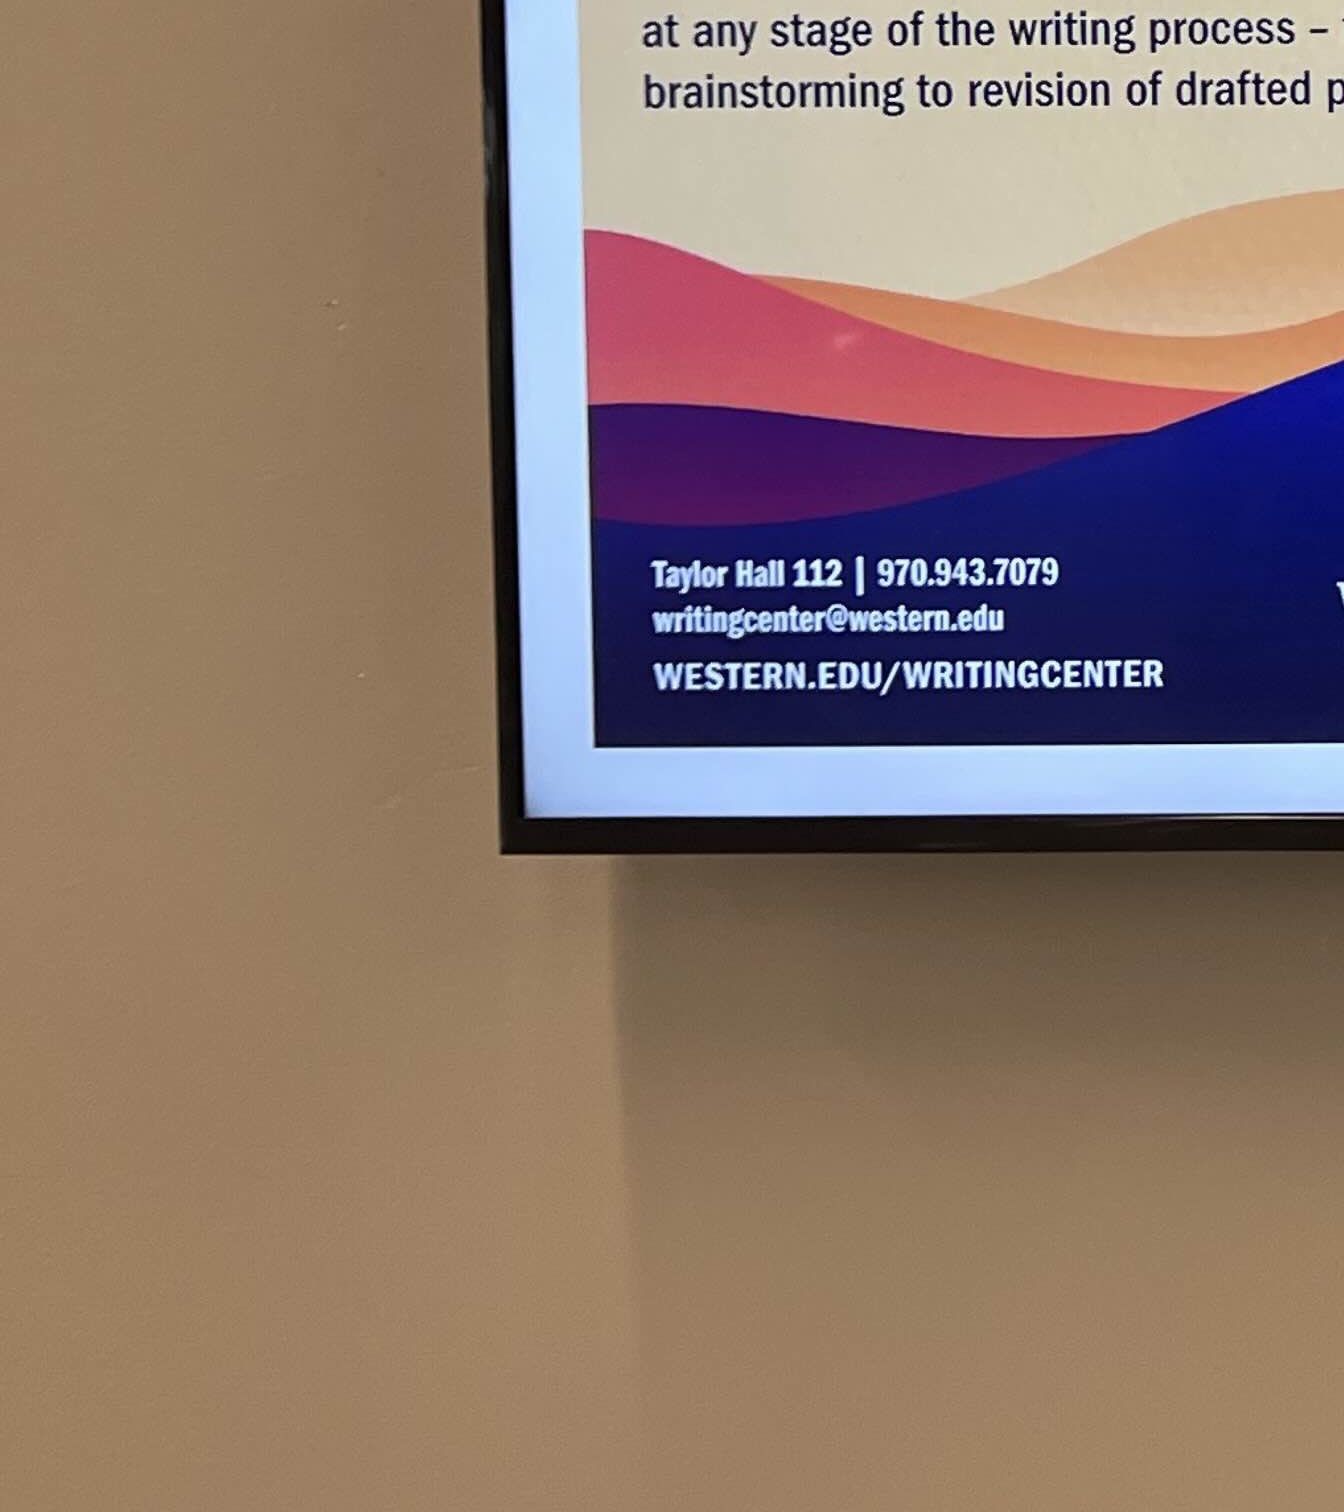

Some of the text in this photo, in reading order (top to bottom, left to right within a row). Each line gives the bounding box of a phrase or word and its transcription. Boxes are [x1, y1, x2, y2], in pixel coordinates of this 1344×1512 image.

[643, 15, 680, 47] at
[694, 21, 757, 56] any
[771, 14, 872, 56] stage
[888, 10, 924, 46] of
[936, 11, 994, 46] the
[1009, 10, 1136, 54] writing
[1150, 18, 1295, 53] process
[645, 73, 904, 116] brainstorming
[916, 75, 952, 107] to
[969, 72, 1110, 107] revision
[1127, 70, 1162, 106] of
[1176, 70, 1310, 106] drafted
[651, 560, 728, 594] Taylor
[736, 560, 785, 587] Hall
[793, 559, 843, 587] 112
[878, 557, 1058, 586] 970.943.7079
[652, 604, 1004, 639] writingcenter@western.edu
[654, 660, 1163, 696] WESTERN.EDU/WRITINGCENTER
